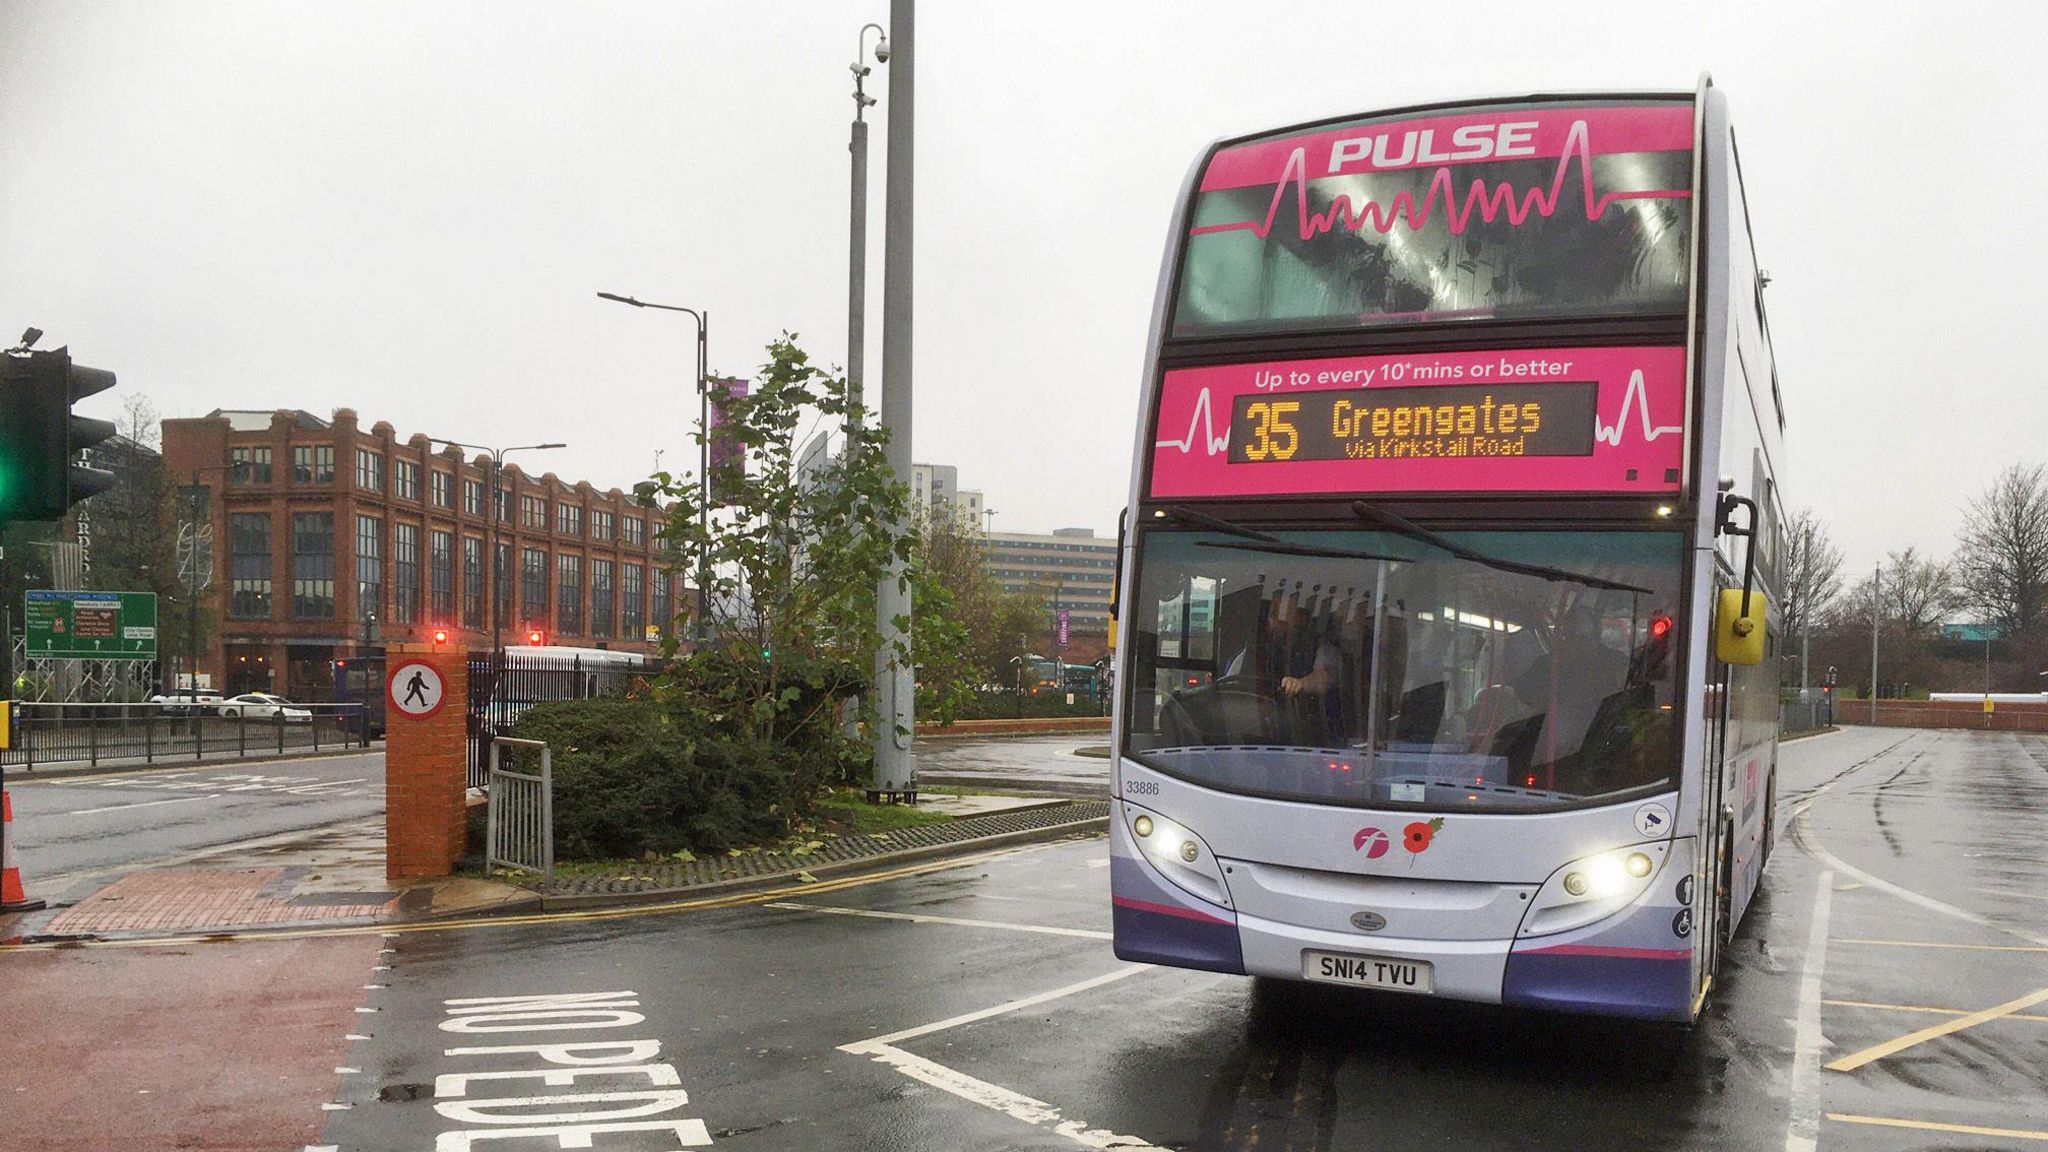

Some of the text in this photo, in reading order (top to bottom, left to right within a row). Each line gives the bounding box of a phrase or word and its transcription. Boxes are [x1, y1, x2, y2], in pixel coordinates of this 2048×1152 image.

[1327, 121, 1539, 173] PULSE
[1255, 370, 1283, 391] Up
[1289, 370, 1311, 386] to
[1317, 367, 1375, 387] every
[1470, 363, 1494, 377] or
[1499, 358, 1573, 377] better
[1245, 395, 1542, 460] 35 Greengates
[1345, 435, 1526, 459] via Kirkstall Road
[1126, 780, 1160, 796] 33886
[1320, 956, 1417, 986] SN14 TVU
[434, 989, 714, 1152] NO PEDE
